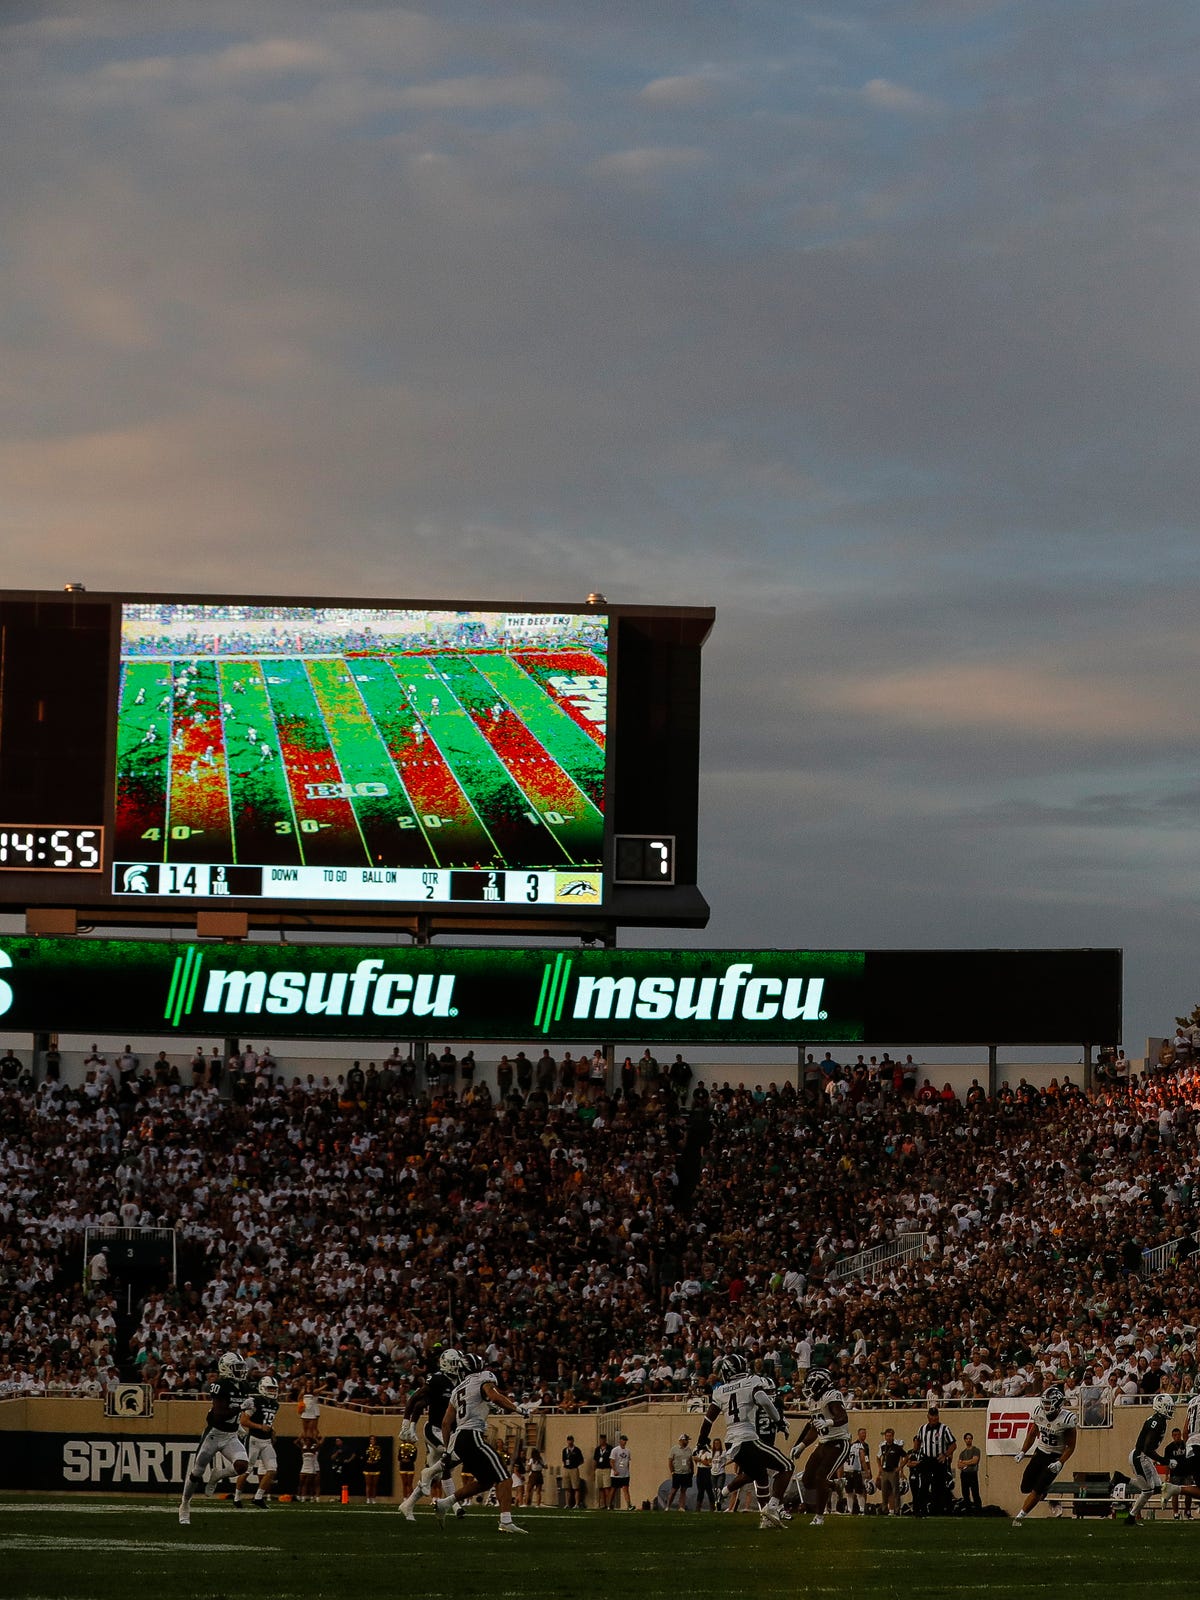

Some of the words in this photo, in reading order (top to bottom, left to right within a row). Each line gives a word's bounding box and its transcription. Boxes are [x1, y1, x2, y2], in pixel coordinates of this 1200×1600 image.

[508, 617, 525, 626] THE
[0, 830, 98, 867] 14:55
[650, 842, 668, 874] 7
[168, 866, 197, 894] 14
[216, 866, 226, 881] 3
[271, 868, 298, 881] DOWN
[323, 870, 334, 882] TO
[336, 870, 347, 882] GO
[362, 870, 383, 883] BALL
[385, 871, 397, 883] ON
[421, 872, 439, 885] QTR
[488, 872, 496, 887] 2
[212, 881, 230, 895] TOL
[426, 885, 434, 899] 2
[483, 887, 500, 901] TOL
[526, 874, 539, 902] 3
[203, 959, 456, 1017] msufcu
[573, 963, 825, 1020] msufcu
[127, 1248, 134, 1258] 3
[209, 1382, 221, 1394] 30
[457, 1388, 467, 1419] 5
[728, 1393, 742, 1423] 4
[1150, 1419, 1158, 1429] 9
